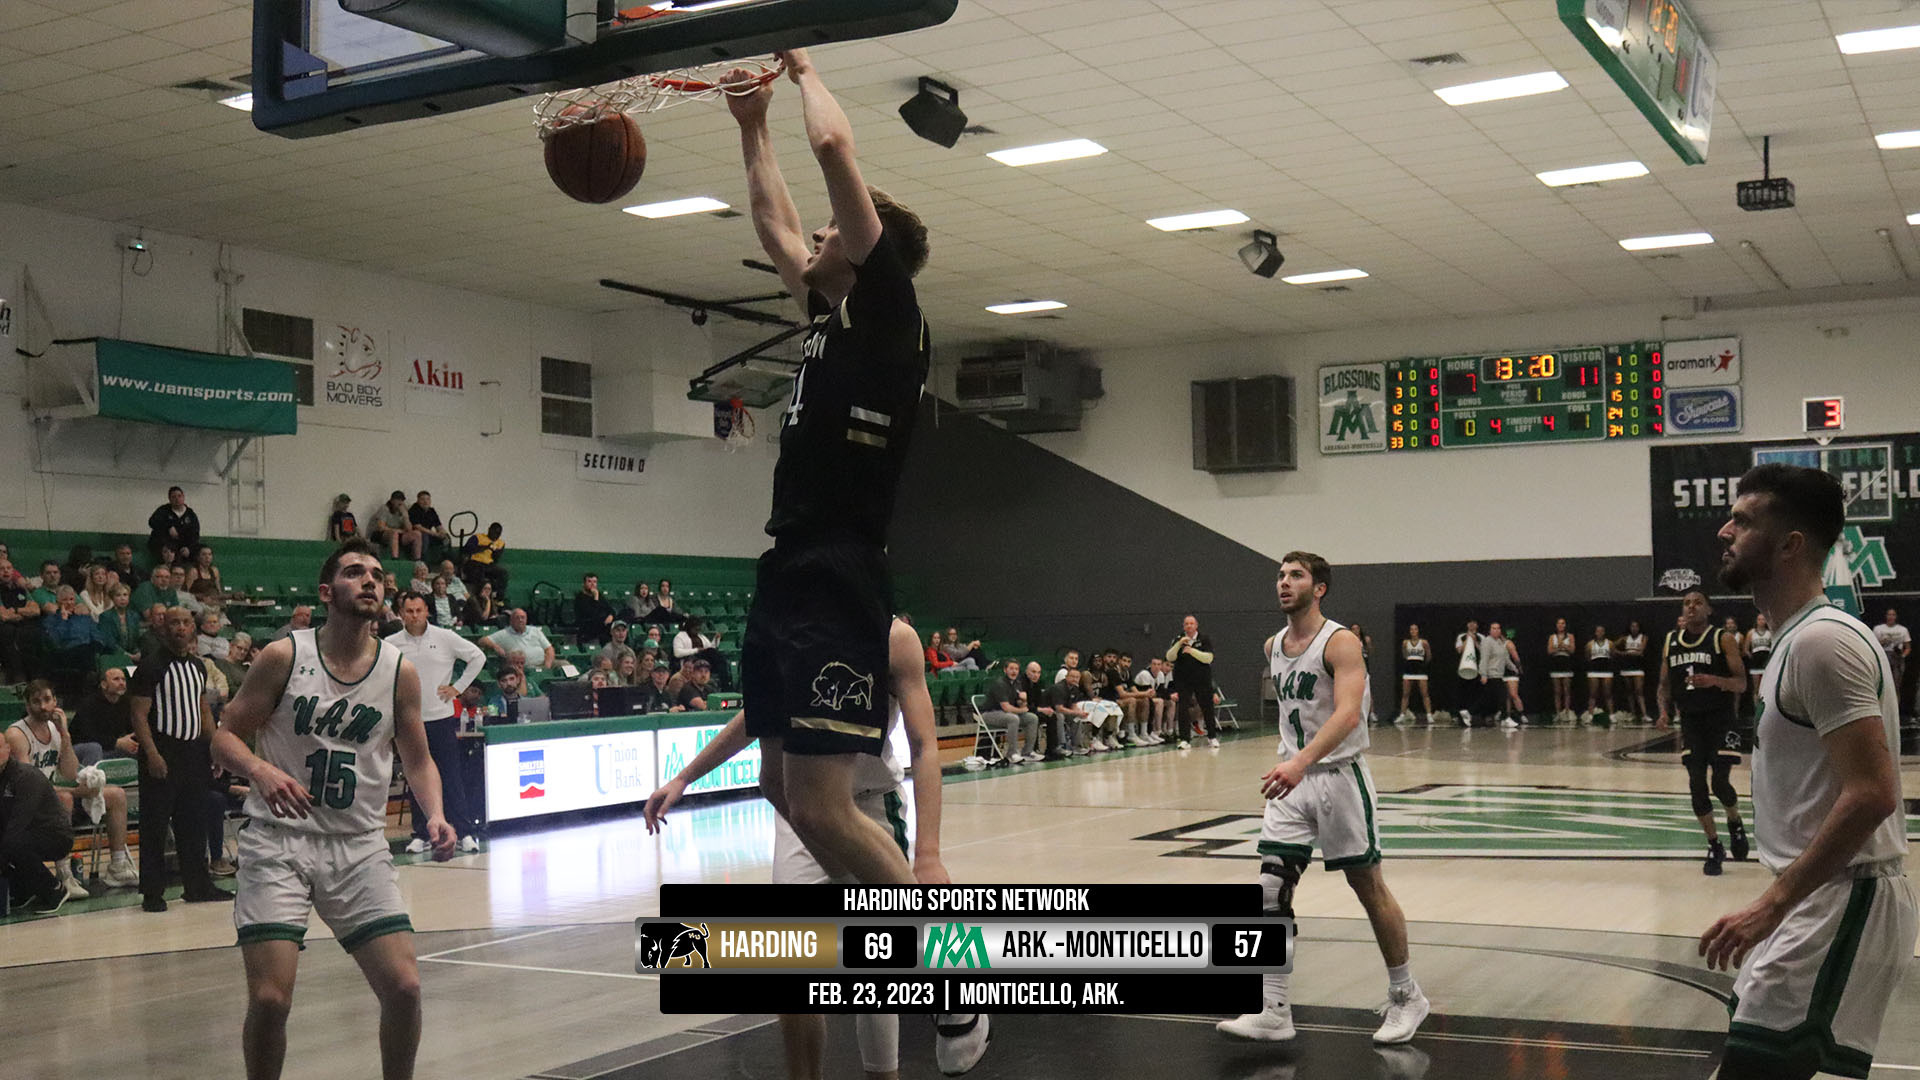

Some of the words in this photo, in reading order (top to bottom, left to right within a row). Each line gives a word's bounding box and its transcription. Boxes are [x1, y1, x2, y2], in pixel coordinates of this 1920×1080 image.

[1562, 351, 1601, 363] VISITOR
[1617, 355, 1622, 366] 1
[1630, 354, 1638, 366] 0
[1652, 352, 1661, 365] 0
[1667, 355, 1716, 370] aramark
[1447, 360, 1475, 371] HOME
[408, 359, 464, 390] Akin
[1323, 369, 1381, 396] BLOSSOMS
[1397, 371, 1403, 381] 1
[1409, 370, 1417, 381] 0
[1430, 368, 1438, 380] 0
[1580, 367, 1599, 387] 11
[1615, 372, 1622, 385] 3
[1630, 371, 1638, 383] 0
[1652, 370, 1661, 382] 0
[102, 374, 293, 402] www.uamsports.com
[327, 381, 353, 393] BAD
[357, 384, 382, 395] BOY
[1465, 373, 1477, 393] 7
[327, 392, 383, 407] MOWERS
[1395, 386, 1403, 399] 3
[1410, 386, 1417, 398] 0
[1430, 384, 1438, 397] 6
[1611, 389, 1623, 402] 15
[1630, 388, 1638, 401] 0
[1652, 387, 1662, 399] 0
[1392, 403, 1403, 415] 12
[1410, 403, 1418, 414] 0
[1434, 402, 1439, 412] 1
[1607, 407, 1623, 420] 24
[1631, 406, 1638, 418] 0
[1654, 404, 1662, 416] 7
[1824, 400, 1841, 427] 3
[1392, 420, 1403, 432] 15
[1410, 419, 1418, 431] 0
[1431, 418, 1439, 430] 0
[1465, 419, 1476, 436] 0
[1490, 418, 1502, 433] 4
[1543, 415, 1555, 431] 4
[1514, 425, 1533, 433] LEFT
[1585, 413, 1590, 429] 1
[1609, 424, 1624, 437] 34
[1631, 423, 1639, 435] 0
[1653, 423, 1662, 433] 4
[1390, 436, 1404, 449] 33
[1410, 435, 1418, 447] 0
[1431, 434, 1440, 447] 0
[584, 453, 634, 472] SECTION
[1670, 652, 1712, 668] HARDING
[293, 695, 383, 744] UAM
[1288, 708, 1305, 750] 1
[592, 742, 637, 795] Union
[305, 748, 357, 810] 15
[615, 767, 642, 789] Bank
